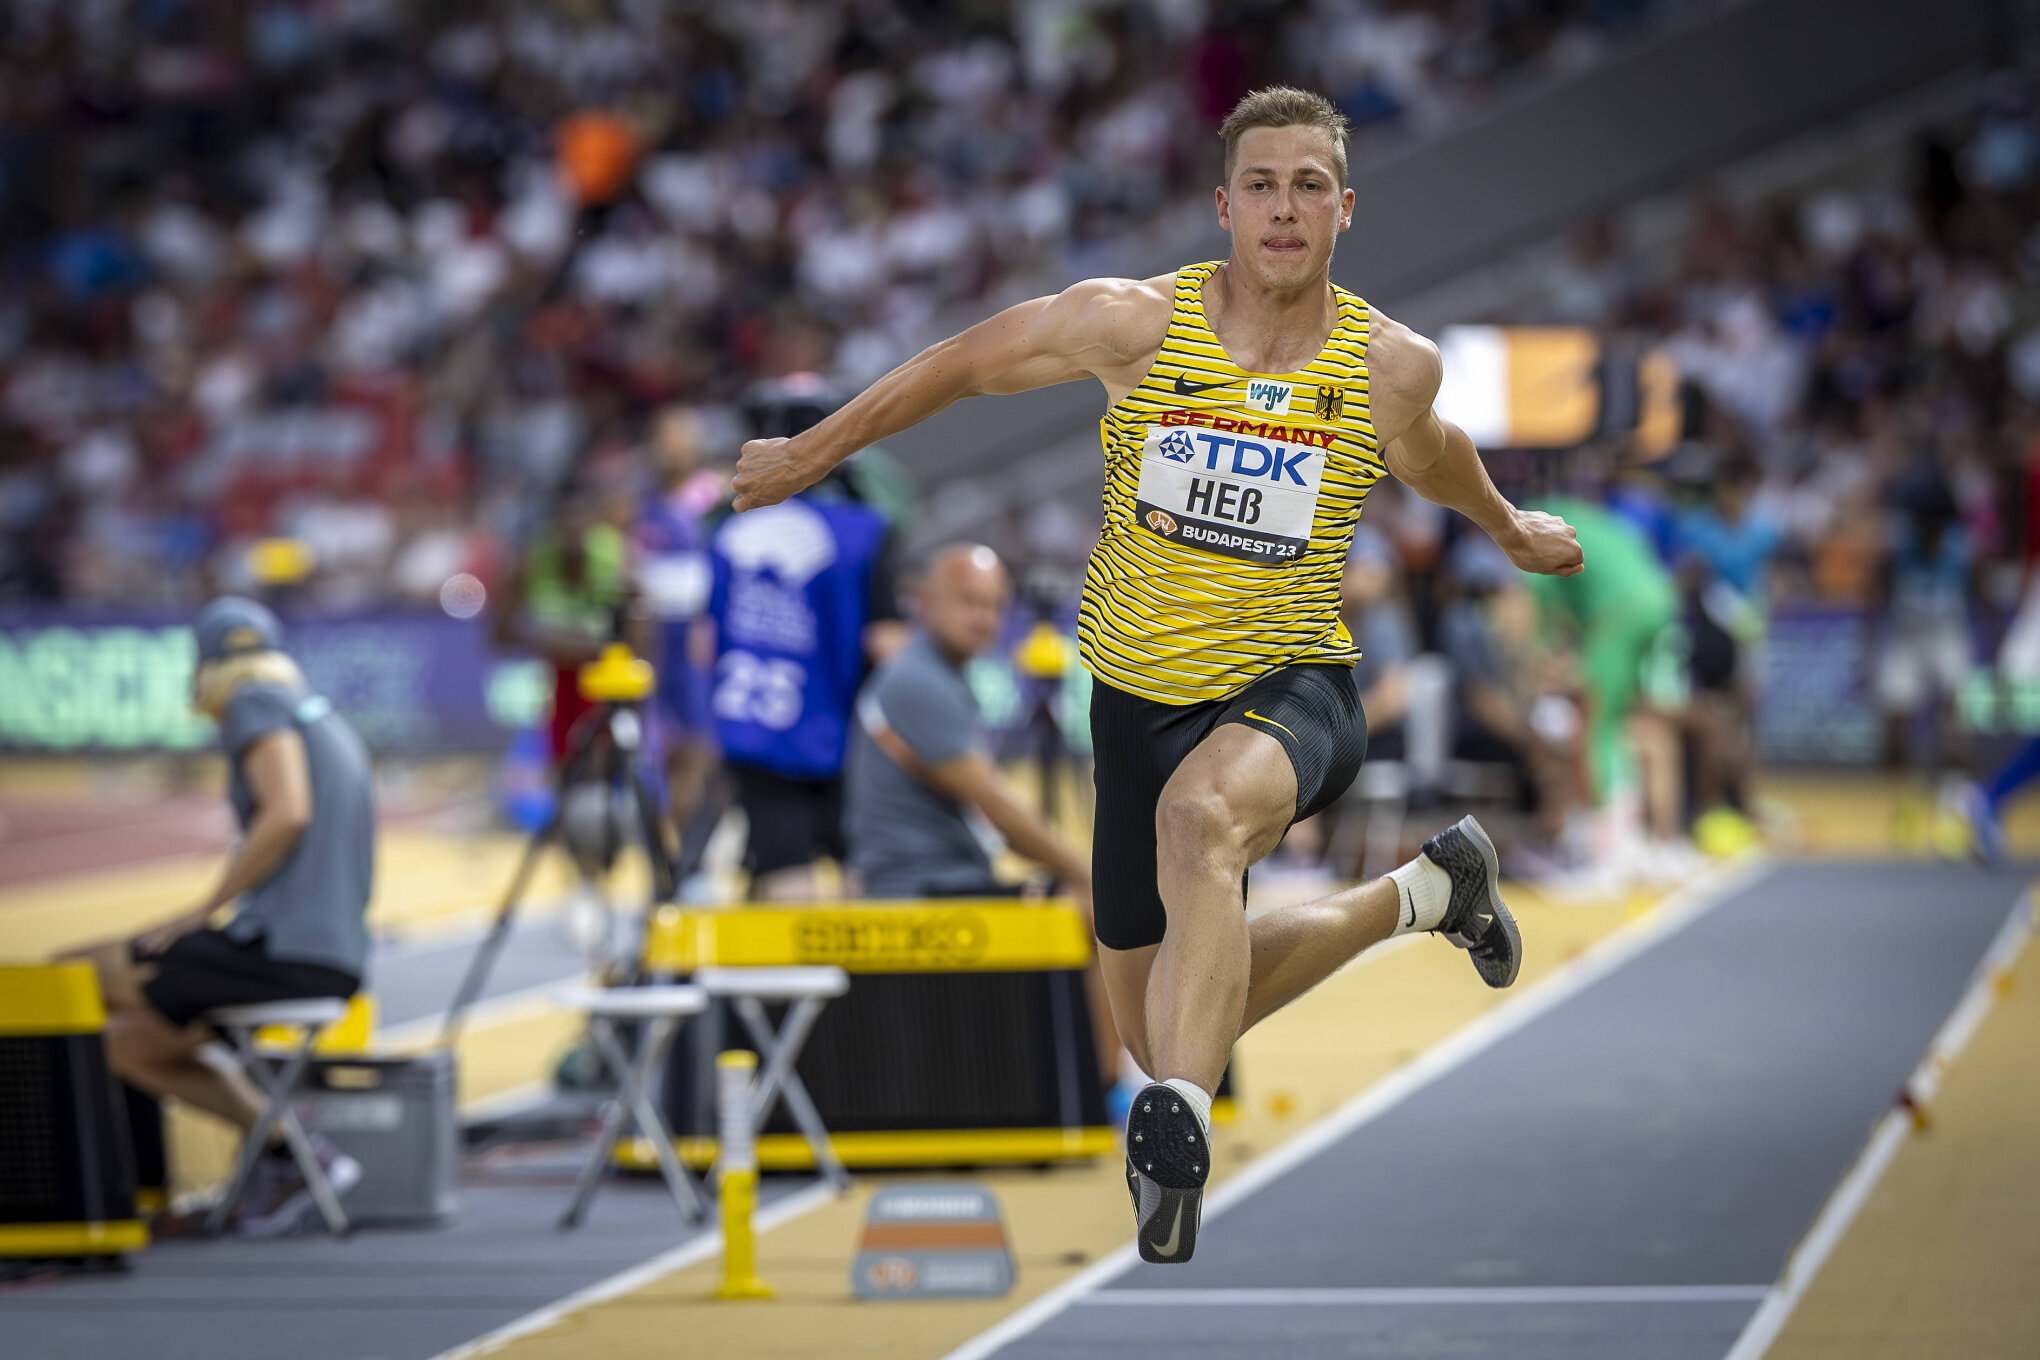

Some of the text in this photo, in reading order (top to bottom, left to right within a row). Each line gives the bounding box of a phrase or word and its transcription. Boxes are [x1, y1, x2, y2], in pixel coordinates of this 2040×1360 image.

[1160, 410, 1339, 450] GERMANY
[1196, 432, 1315, 487] TDK
[1185, 477, 1263, 525] HEß
[1182, 524, 1297, 558] BUDAPEST 23
